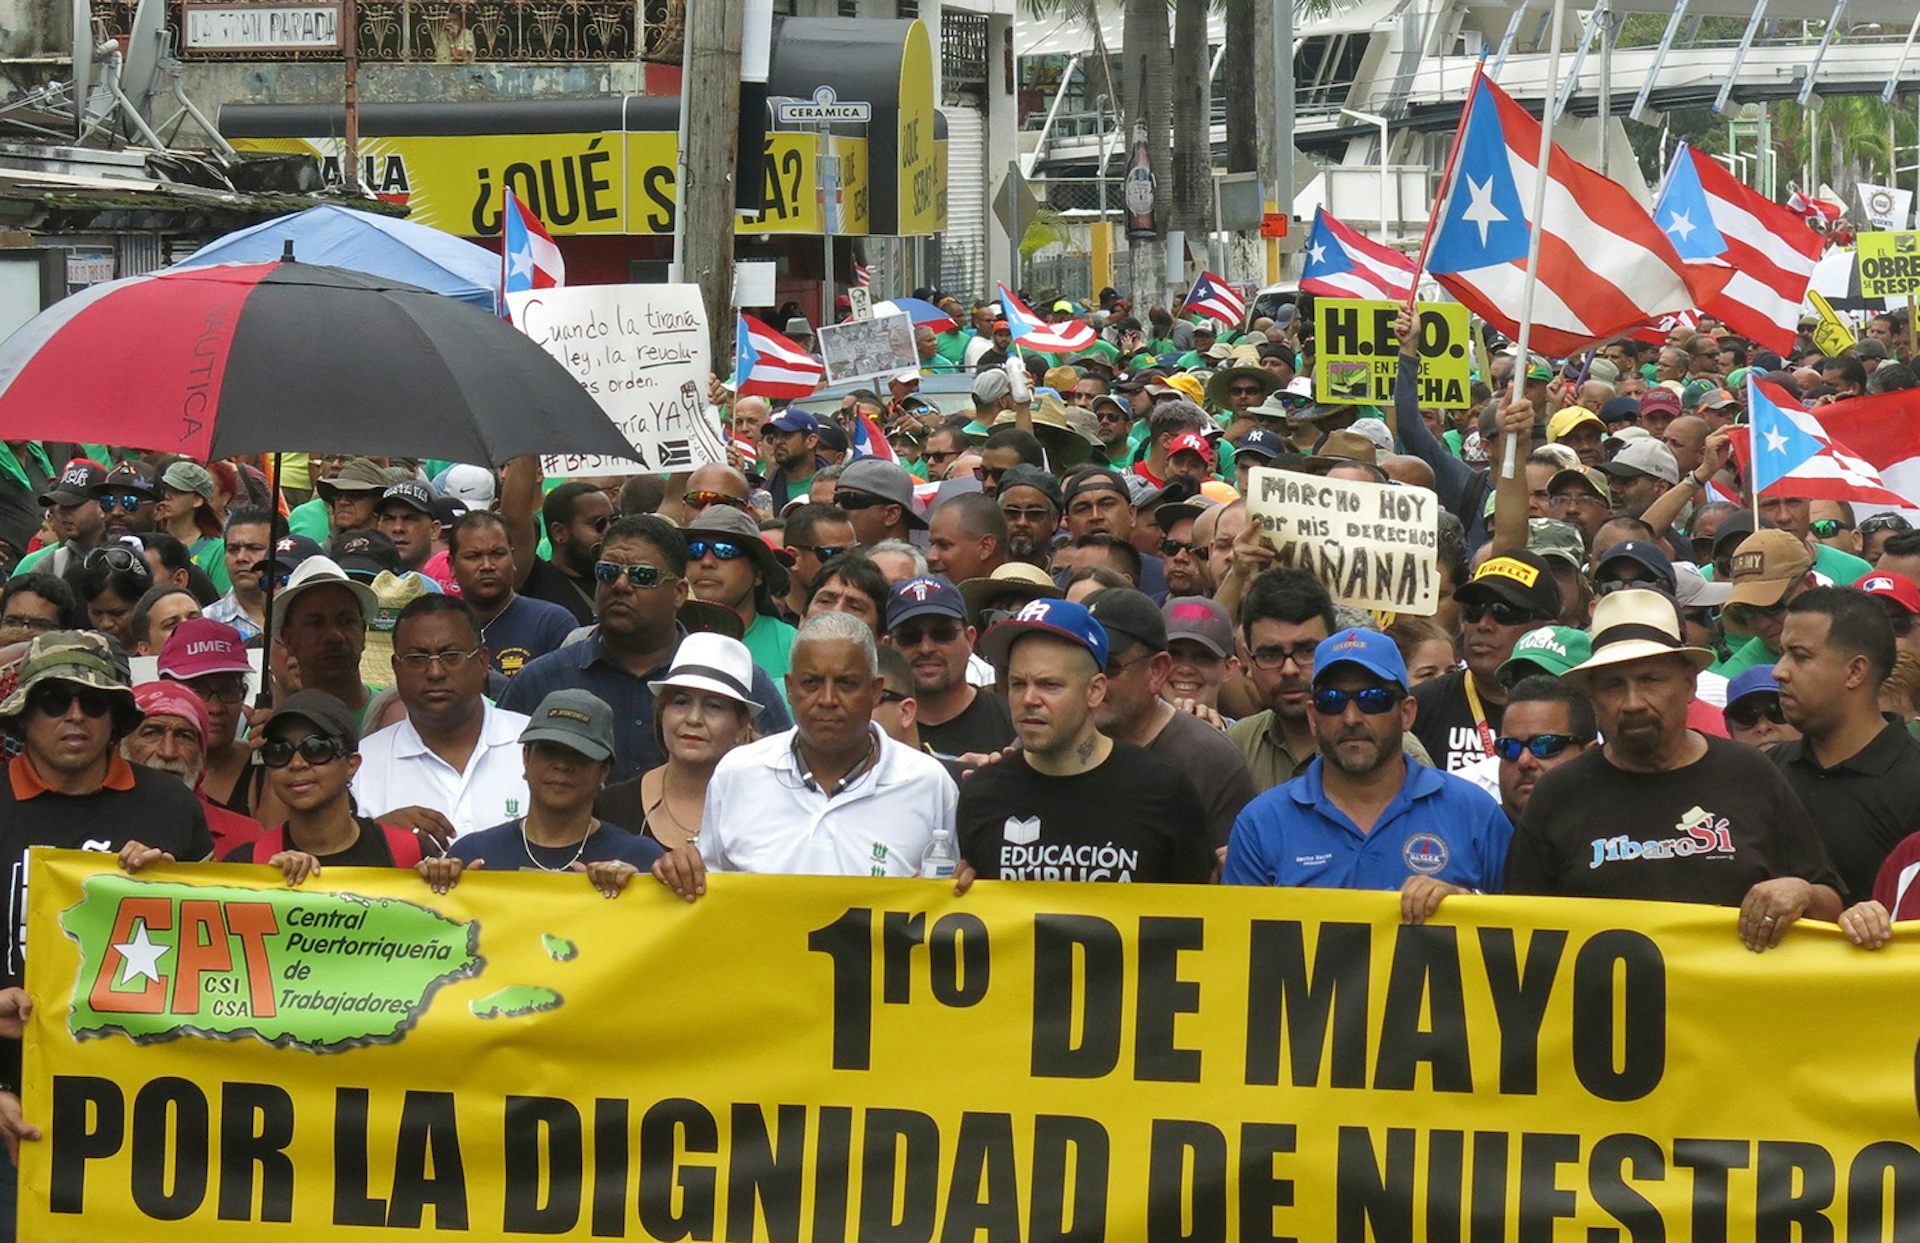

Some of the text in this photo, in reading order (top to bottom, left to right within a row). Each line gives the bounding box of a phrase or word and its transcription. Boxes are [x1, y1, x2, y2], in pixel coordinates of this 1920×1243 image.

[270, 12, 335, 41] PARADA
[789, 107, 861, 118] CERAMICA
[472, 137, 618, 235] ¿QUÉ
[523, 299, 700, 346] Cuando la tiranía
[605, 345, 626, 364] la
[1374, 361, 1390, 374] EN
[608, 371, 658, 393] orden.
[649, 401, 682, 432] YA
[1261, 476, 1426, 523] MARCHO HOY
[1346, 522, 1436, 548] DERECHOS
[1479, 561, 1532, 581] PIRELLI
[1000, 841, 1138, 872] EDUCACIÓN
[286, 907, 369, 931] Central
[89, 897, 279, 1018] CPT
[285, 933, 452, 962] Puertorriqueña
[283, 959, 311, 981] de
[204, 976, 241, 994] CSI
[212, 1001, 248, 1017] CSA
[279, 989, 414, 1016] Trabajadores
[808, 907, 1666, 1102] 1ro DE MAYO
[49, 1075, 1920, 1243] POR LA DIGNIDAD DE NUESTRO
